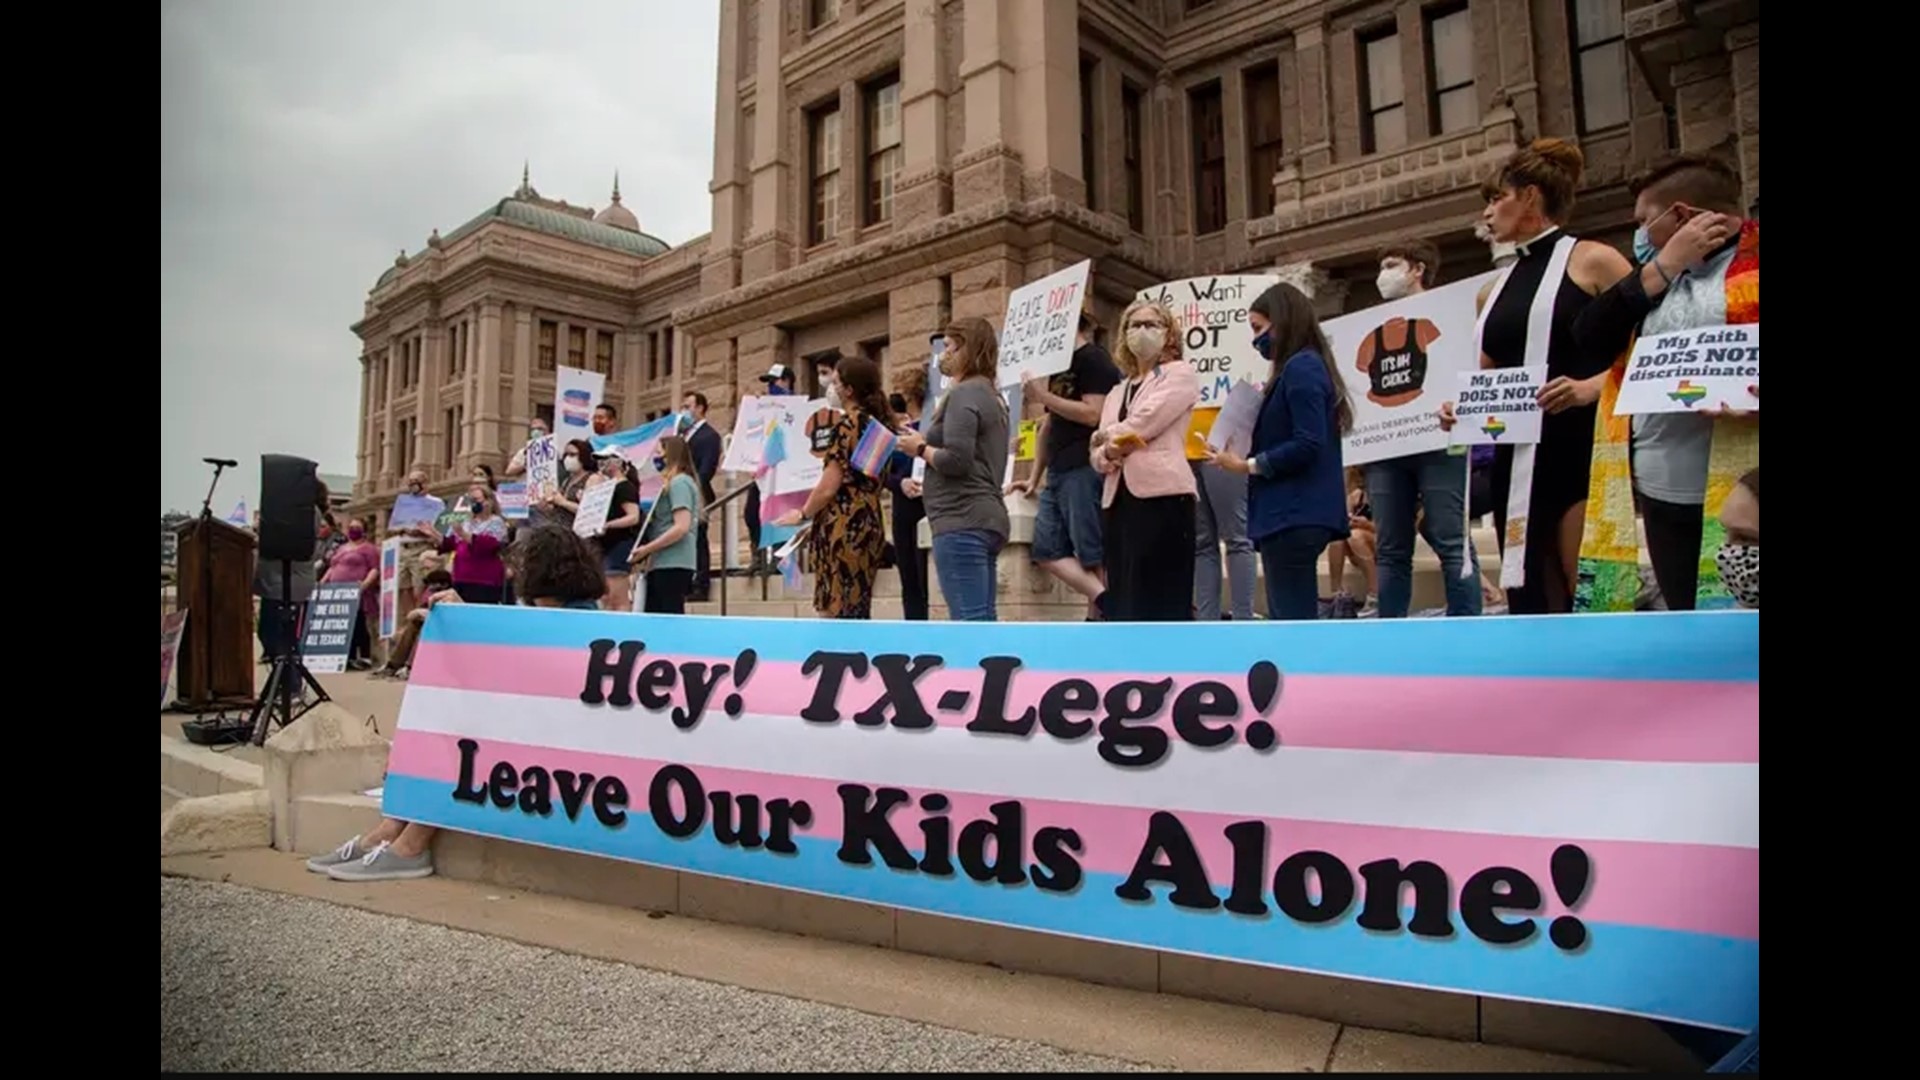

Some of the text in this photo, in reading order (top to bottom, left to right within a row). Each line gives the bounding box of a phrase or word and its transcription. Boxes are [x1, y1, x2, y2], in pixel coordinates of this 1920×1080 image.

[1189, 277, 1246, 301] Want
[1043, 310, 1070, 335] KIDS
[1040, 332, 1066, 356] CARE
[1184, 325, 1228, 350] OT
[1656, 329, 1748, 350] My faith
[1636, 346, 1759, 369] DOES NOT
[1470, 371, 1530, 387] My faith
[1459, 385, 1539, 403] DOES NOT
[1381, 413, 1422, 430] DESERVE
[1350, 439, 1362, 448] TO
[1363, 431, 1394, 446] BODILY
[333, 587, 360, 601] ATTACK
[322, 618, 350, 631] ATTACK
[305, 633, 347, 646] ALL TEXANS
[579, 639, 1280, 769] Hey! TX-Lege!
[452, 737, 1591, 952] Leave Our Kids Alone!
